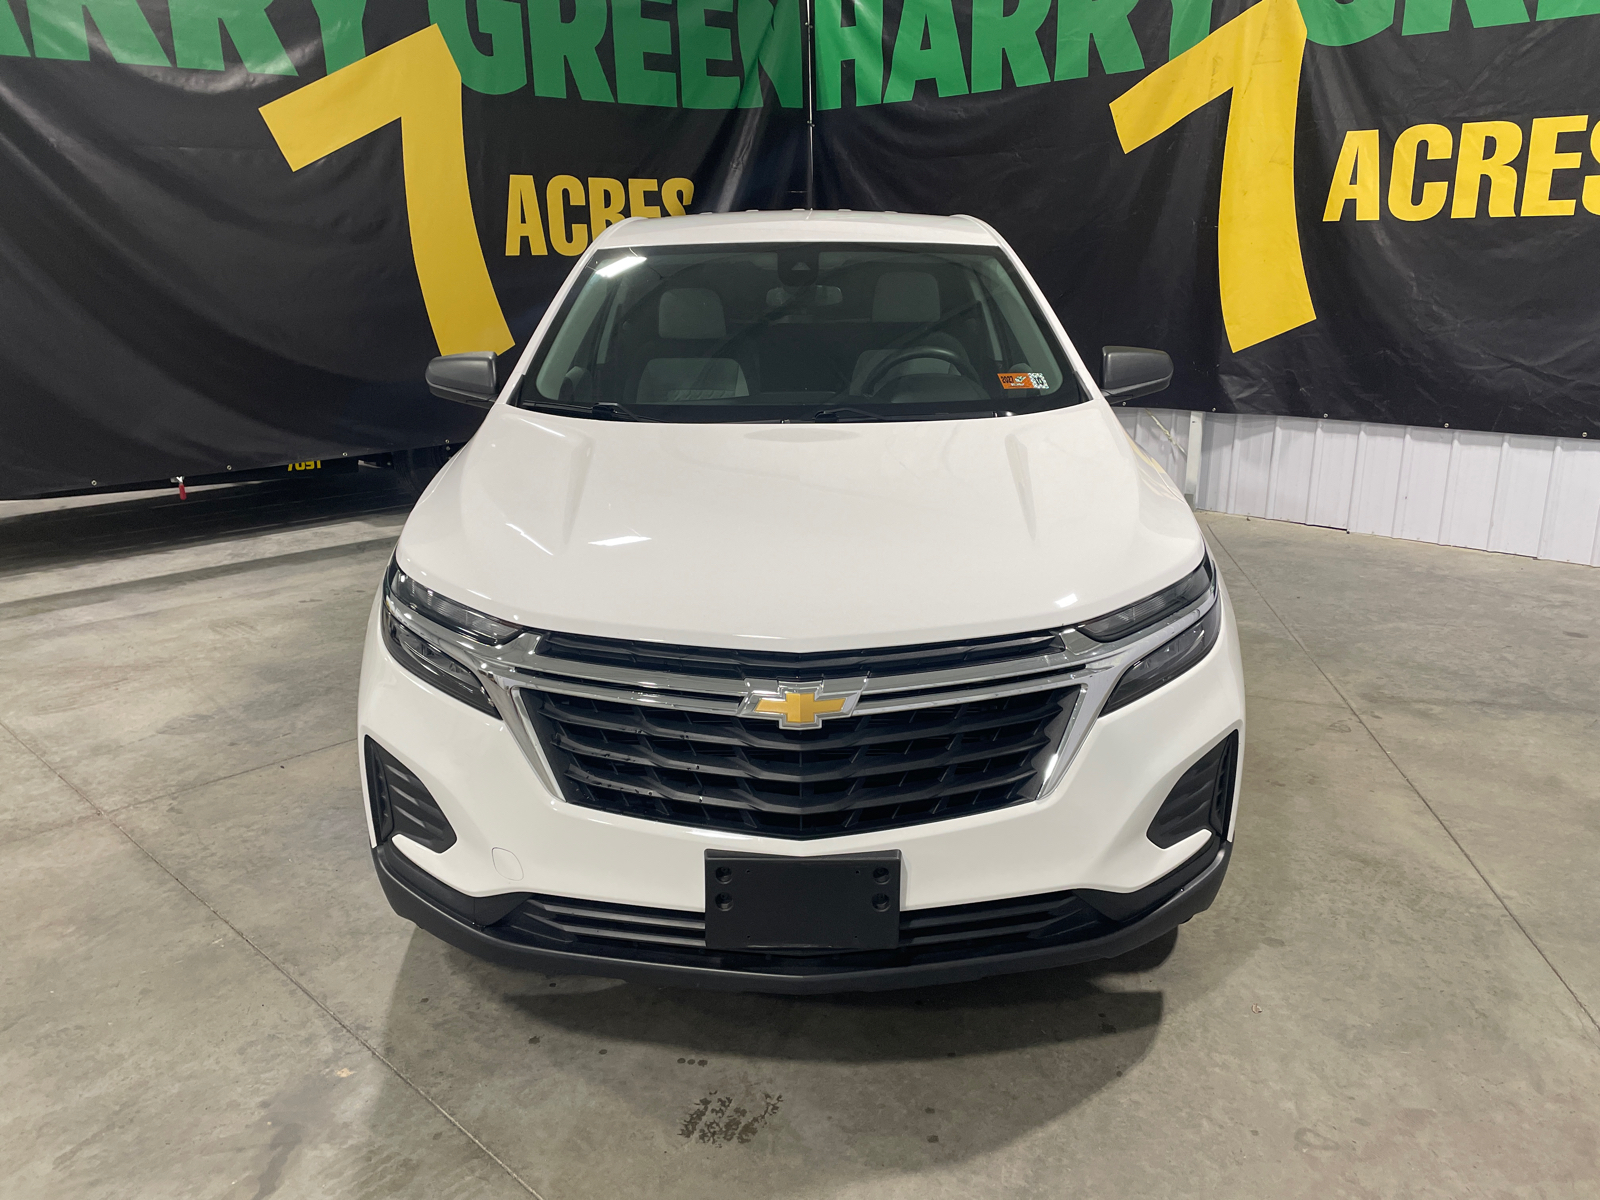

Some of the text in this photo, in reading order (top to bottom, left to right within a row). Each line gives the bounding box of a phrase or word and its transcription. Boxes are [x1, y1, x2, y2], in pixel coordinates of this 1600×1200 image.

[259, 23, 514, 357] 7
[429, 0, 804, 109] GREEN
[1109, 0, 1316, 353] 7
